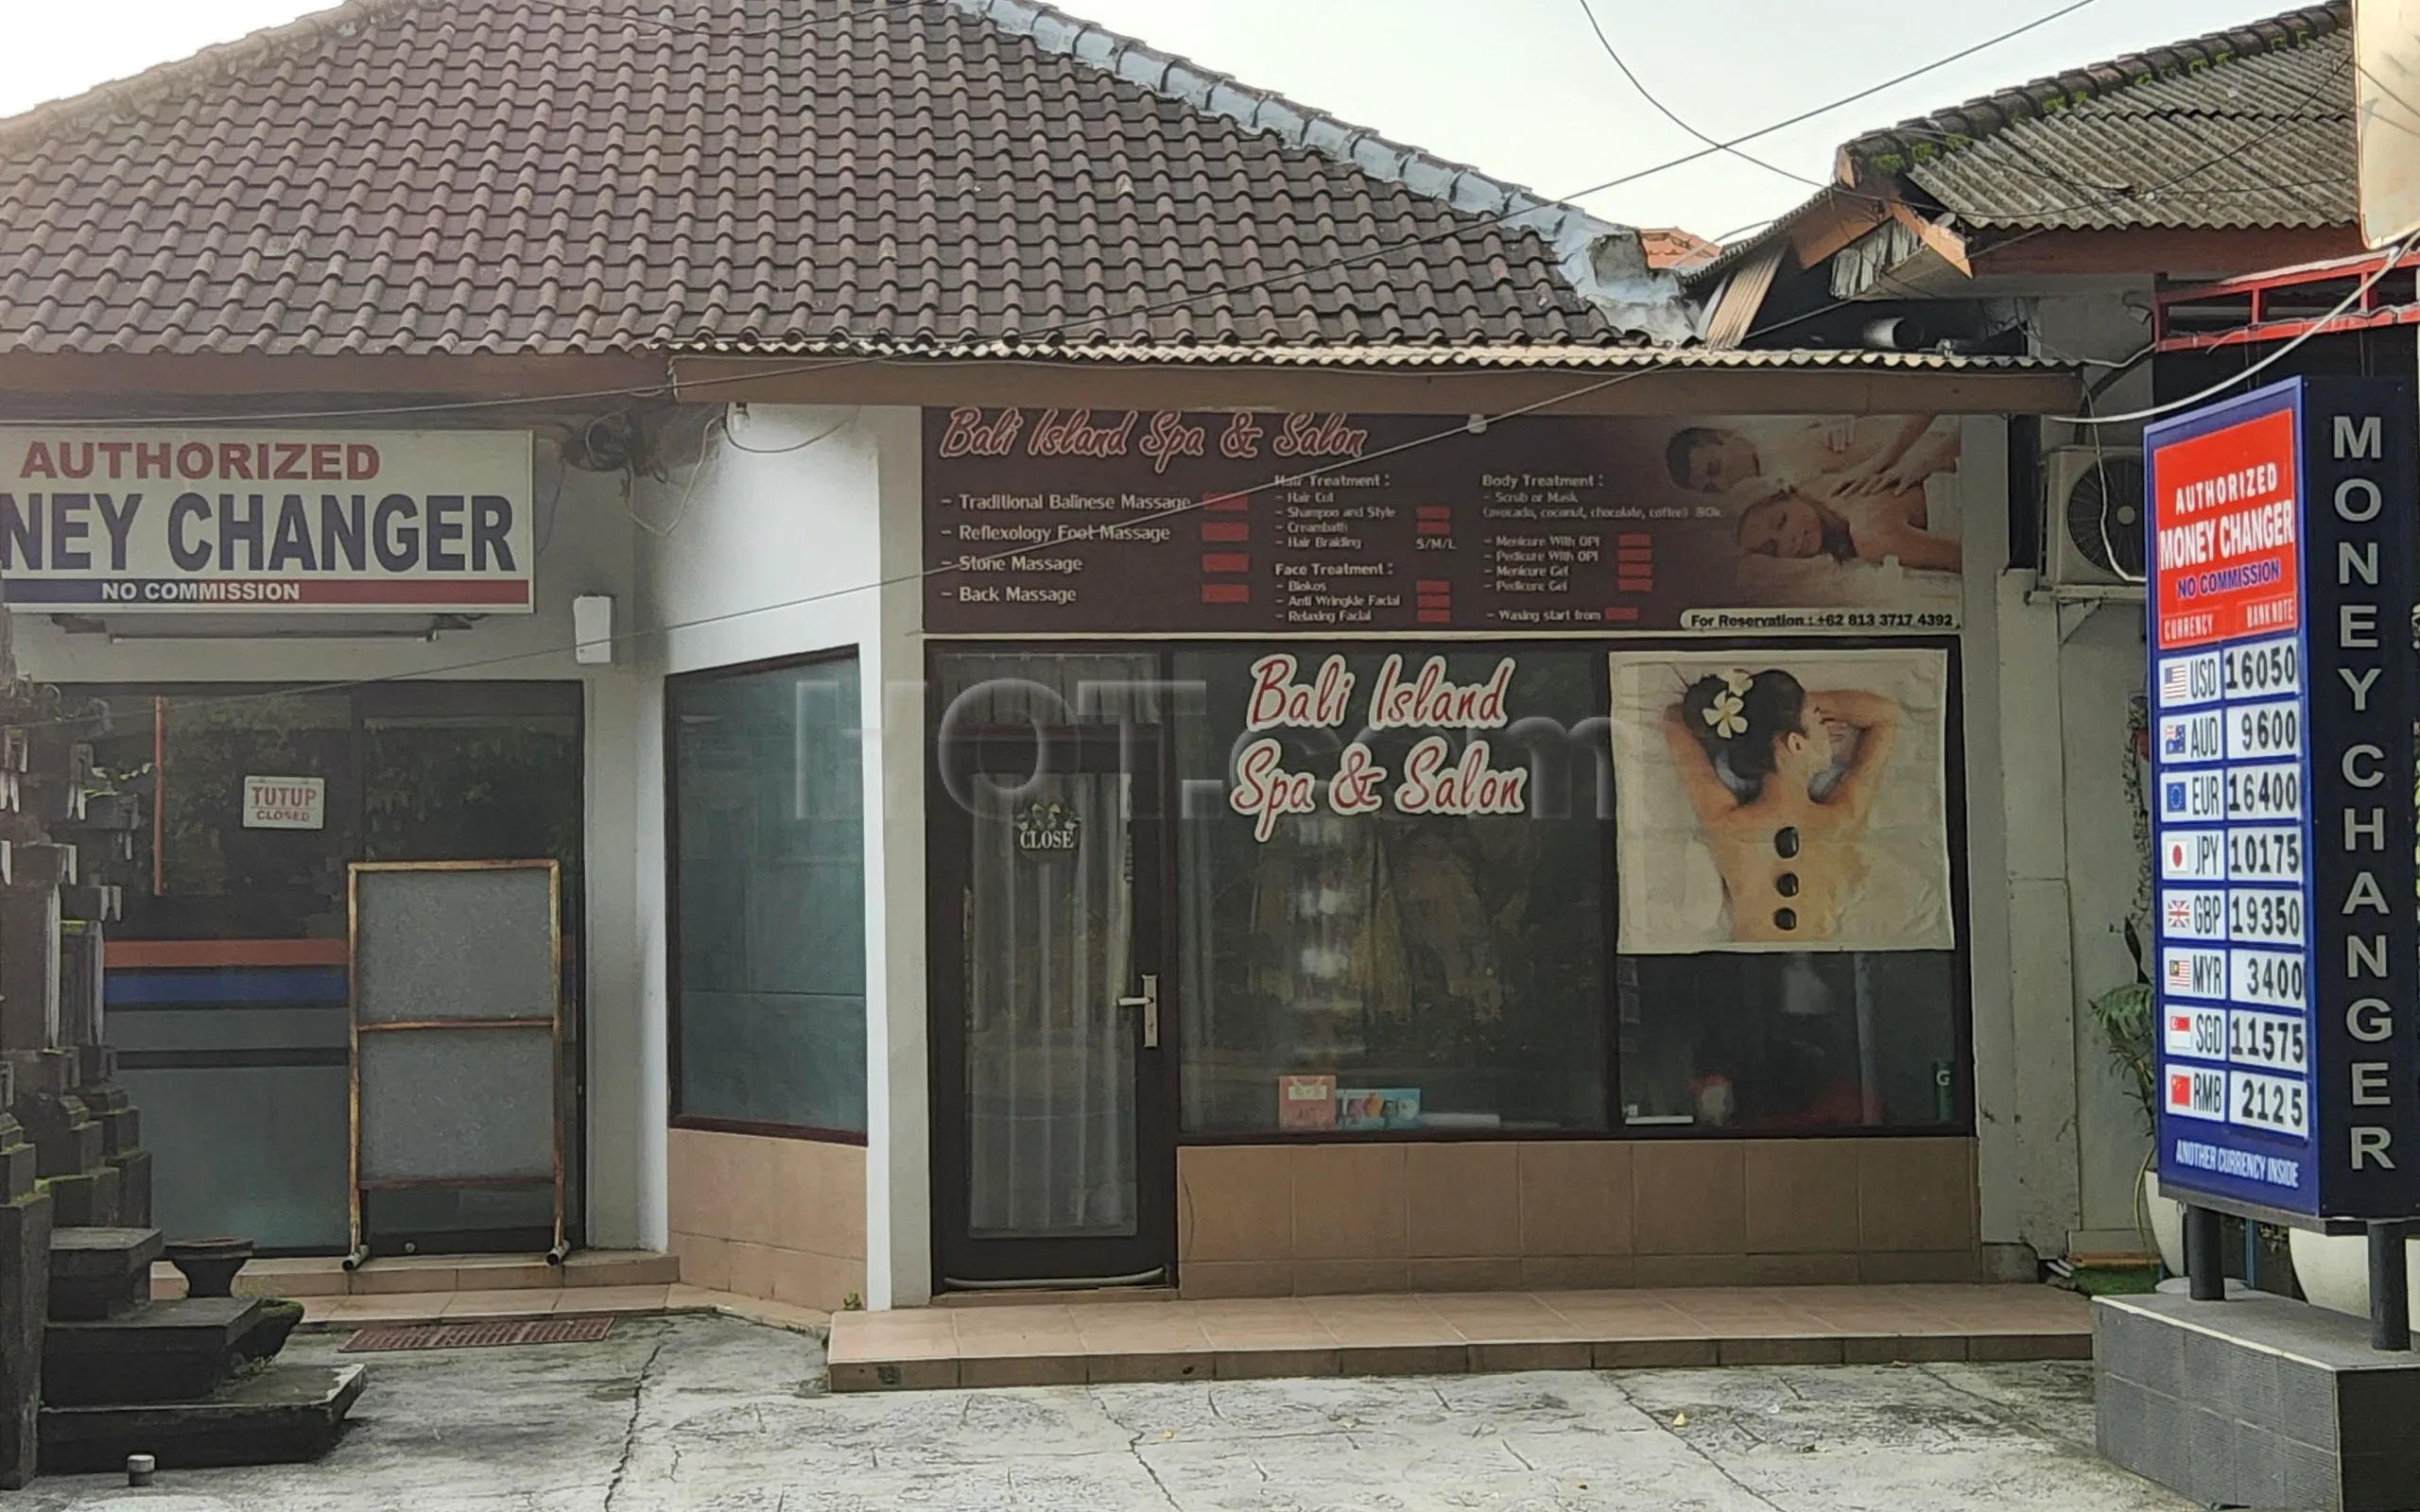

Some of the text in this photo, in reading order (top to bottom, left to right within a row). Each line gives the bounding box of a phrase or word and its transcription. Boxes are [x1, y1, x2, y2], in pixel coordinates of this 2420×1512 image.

[940, 407, 1368, 473] Bali Island Spa & Salon
[19, 441, 380, 481] AUTHORIZED
[1309, 474, 1381, 487] Treatment
[1482, 474, 1517, 490] Body
[1522, 474, 1594, 487] Treatment
[2176, 462, 2277, 515] AUTHORIZED
[959, 493, 1191, 511] Traditional Balinese Massage
[1288, 491, 1334, 504] Hair Cut
[1547, 491, 1579, 503] Mask
[1288, 507, 1396, 520] Shampoo and Style
[167, 492, 518, 573] CHANGER
[959, 524, 1170, 543] Reflexology Foot Massage
[1288, 523, 1348, 533] Creambath
[2159, 499, 2295, 571] MONEY CHANGER
[1288, 537, 1361, 550] Hair Braiding
[1416, 538, 1457, 550] S/M/L
[959, 556, 1082, 575] Stone Massage
[1275, 563, 1307, 576] Face
[1311, 562, 1384, 576] Treatment
[2178, 559, 2280, 598] NO COMMISSION
[101, 582, 300, 600] NO COMMISSION
[959, 586, 1077, 605] Back Massage
[1288, 595, 1312, 607] Anti
[1368, 595, 1400, 606] Facial
[1288, 610, 1371, 624] Relaxing Facial
[1498, 609, 1601, 624] Waxing start from
[1691, 614, 1714, 627] For
[1719, 614, 1804, 627] Reservation
[1848, 614, 1876, 627] 813
[1878, 613, 1912, 627] 3717
[1917, 613, 1953, 627] 4392
[2164, 598, 2294, 641] CURRENCY BANK NOTE
[2189, 644, 2296, 699] USD 16050
[1246, 653, 1515, 731] Bali Island
[2190, 710, 2296, 758] AUD 9600
[251, 786, 318, 806] TUTUP
[1230, 736, 1528, 842] Spa & Salon
[2192, 771, 2297, 816] EUR 16400
[256, 810, 310, 821] CLOSED
[1020, 830, 1075, 849] CLOSE
[2195, 833, 2299, 875] JPY 10175
[2193, 895, 2300, 936] GBP 19350
[2192, 954, 2302, 1001] MYR 3400
[2195, 1013, 2304, 1064] SGD 11575
[2193, 1073, 2302, 1127] RMB 2125
[2176, 1139, 2300, 1188] ANOTHER CURRENCY INSIDE
